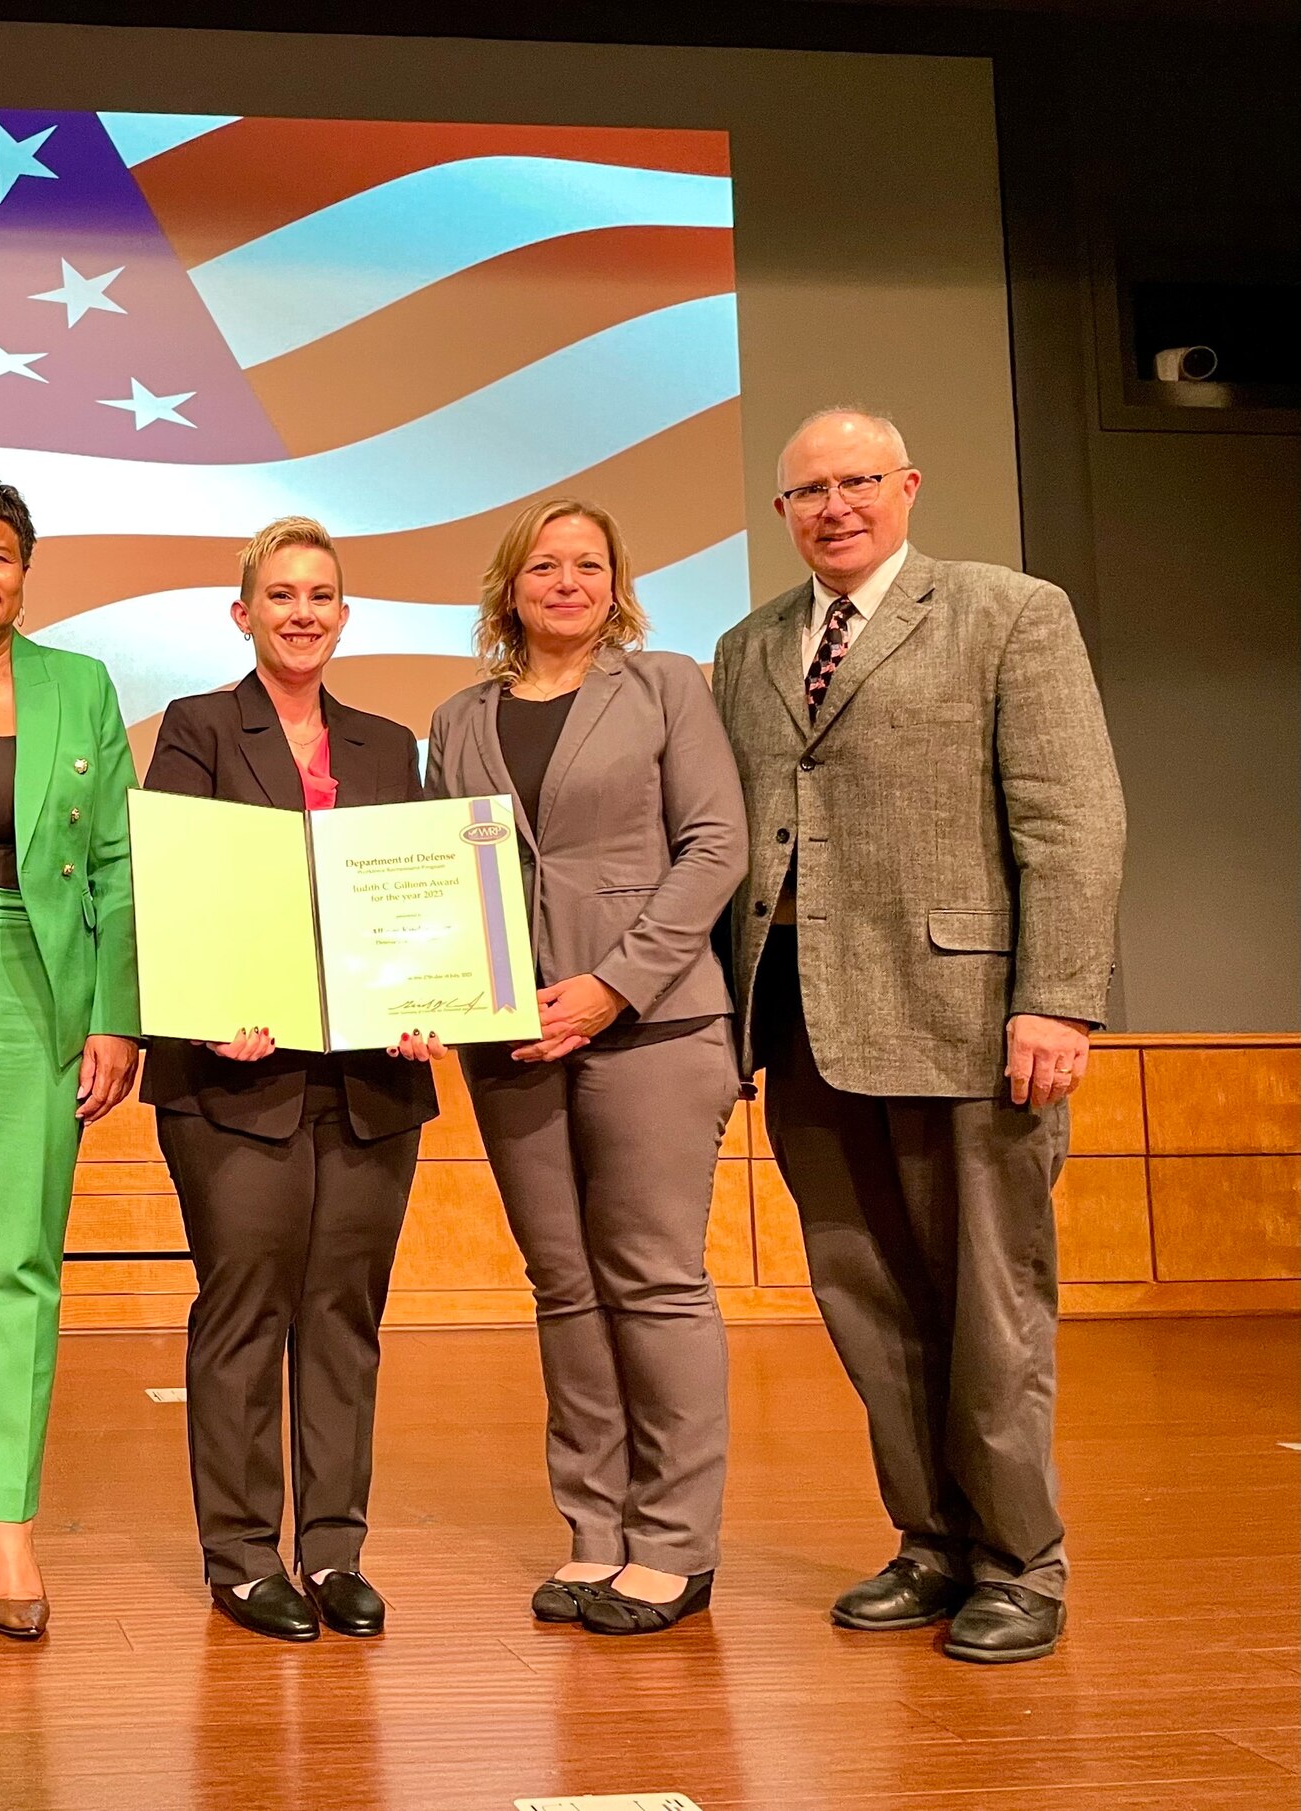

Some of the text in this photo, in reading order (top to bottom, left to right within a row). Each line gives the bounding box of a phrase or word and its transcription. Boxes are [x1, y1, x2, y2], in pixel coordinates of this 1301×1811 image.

[345, 852, 456, 869] Department of Defense
[429, 877, 460, 888] Award
[371, 889, 444, 904] for the year 2023
